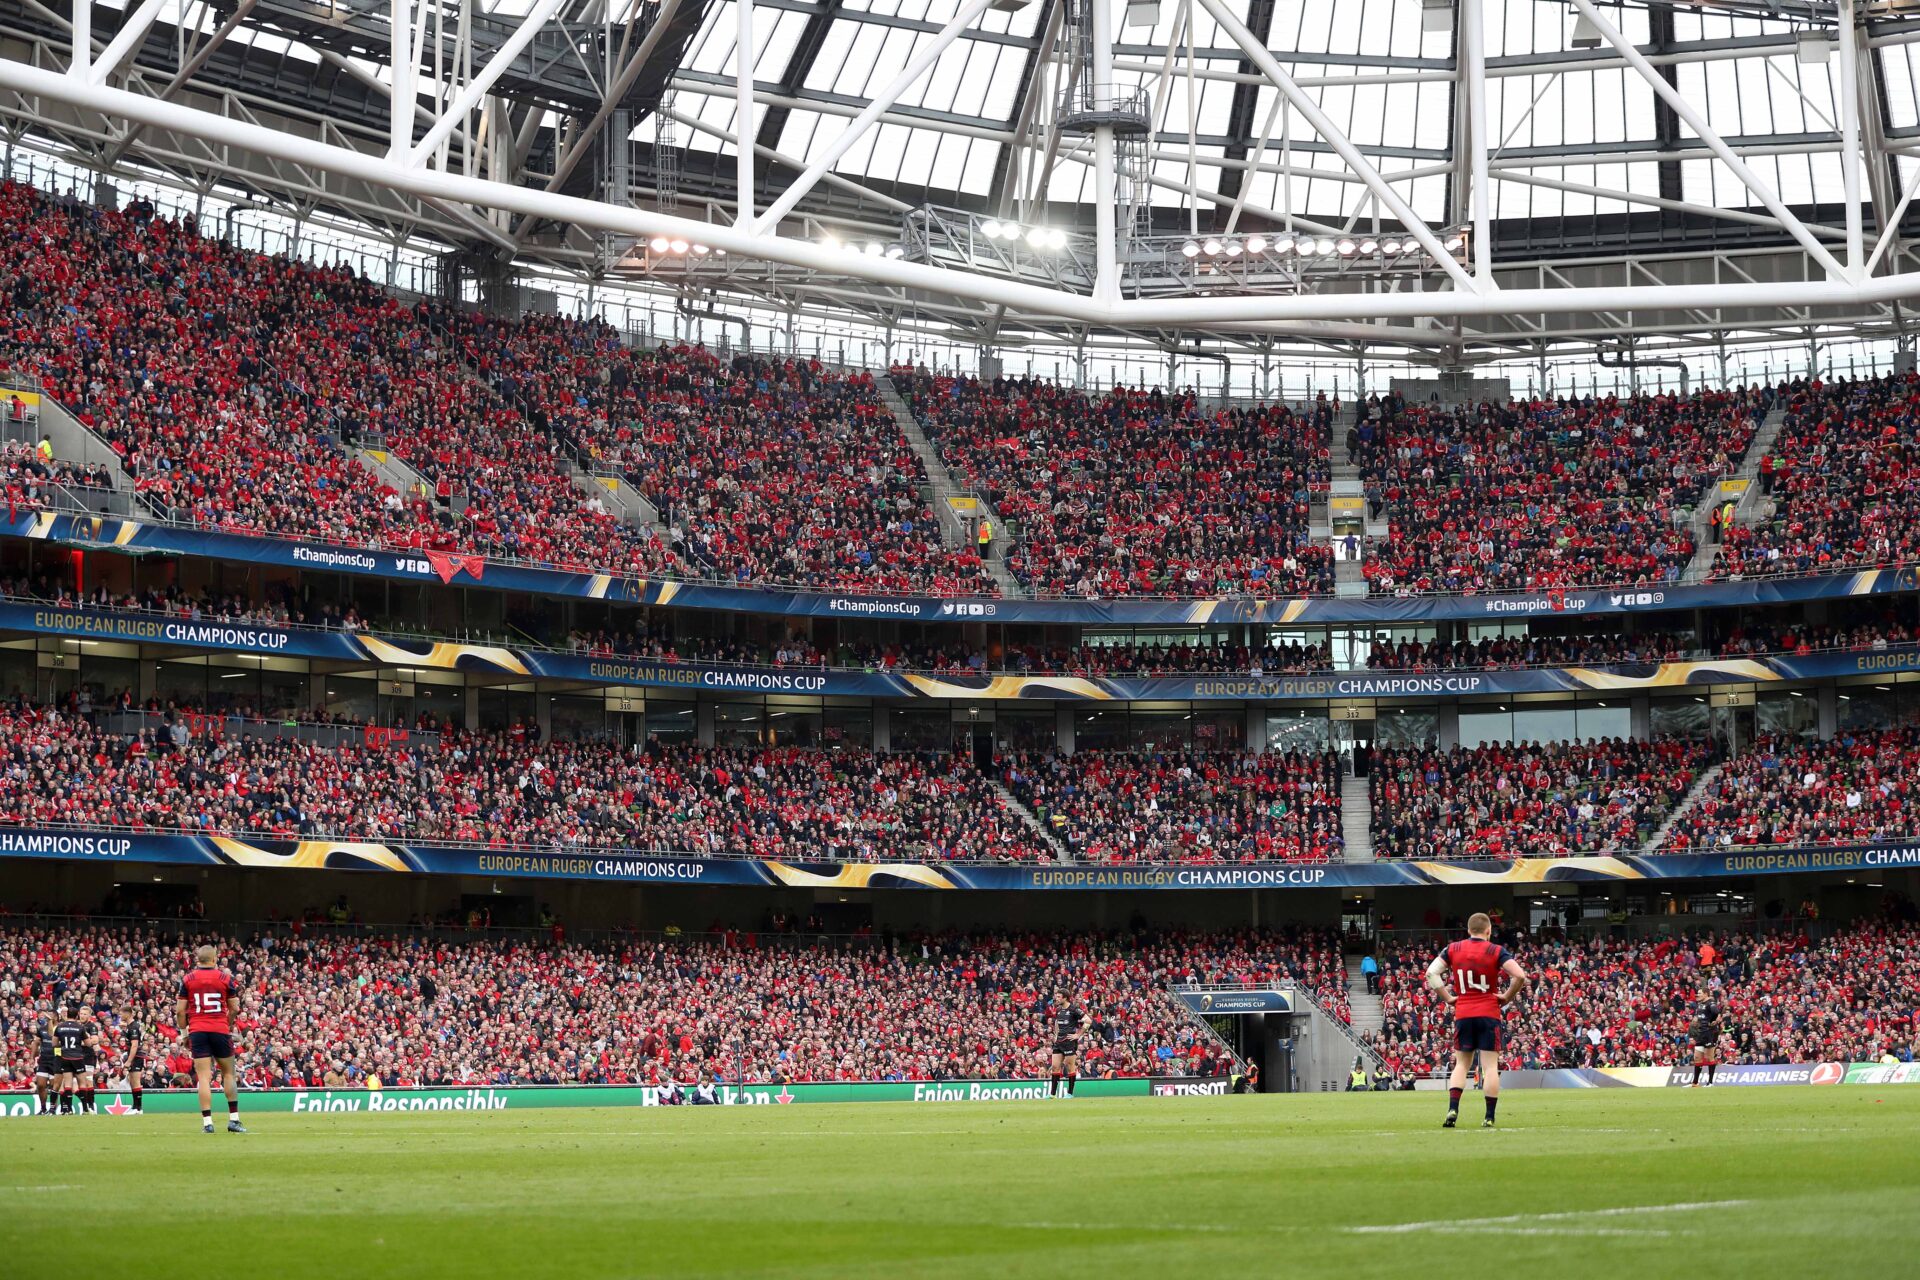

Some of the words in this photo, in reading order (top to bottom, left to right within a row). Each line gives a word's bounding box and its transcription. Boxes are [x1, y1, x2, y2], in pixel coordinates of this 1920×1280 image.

[293, 547, 375, 570] #ChampionsCup
[829, 599, 920, 616] #ChampionsCup
[1486, 598, 1586, 612] #ChampioCup
[35, 612, 115, 633] EUROPEAN
[117, 619, 164, 637] RUGBY
[166, 624, 256, 646] CHAMPIONS
[258, 632, 288, 649] CUP
[590, 663, 655, 680] EUROPEAN
[658, 668, 702, 683] RUGBY
[704, 671, 791, 689] CHAMPIONS
[794, 676, 826, 690] CUP
[1195, 682, 1281, 696] EUROPEAN
[1284, 680, 1336, 694] RUGBY
[1338, 678, 1443, 694] CHAMPIONS
[1445, 677, 1480, 691] CUP
[0, 834, 95, 855] HAMPIONS
[97, 838, 131, 856] CUP
[479, 855, 549, 873] EUROPEAN
[552, 858, 594, 874] RUGBY
[595, 860, 675, 878] CHAMPIONS
[677, 863, 704, 879] CUP
[1725, 854, 1808, 871] EUROPEAN
[1812, 851, 1863, 867] RUGBY
[1865, 848, 1920, 864] CHAM
[1033, 871, 1118, 885] EUROPEAN
[1123, 871, 1174, 885] RUGBY
[1178, 870, 1286, 885] CHAMPIONS
[1289, 869, 1325, 884] CUP
[1457, 968, 1490, 994] 14
[193, 992, 222, 1013] 15
[64, 1036, 76, 1048] 12
[1739, 1070, 1809, 1083] AIRLINES
[914, 1083, 964, 1101] Enjoy
[1174, 1081, 1227, 1096] TISSOT
[293, 1091, 361, 1112] Enjoy
